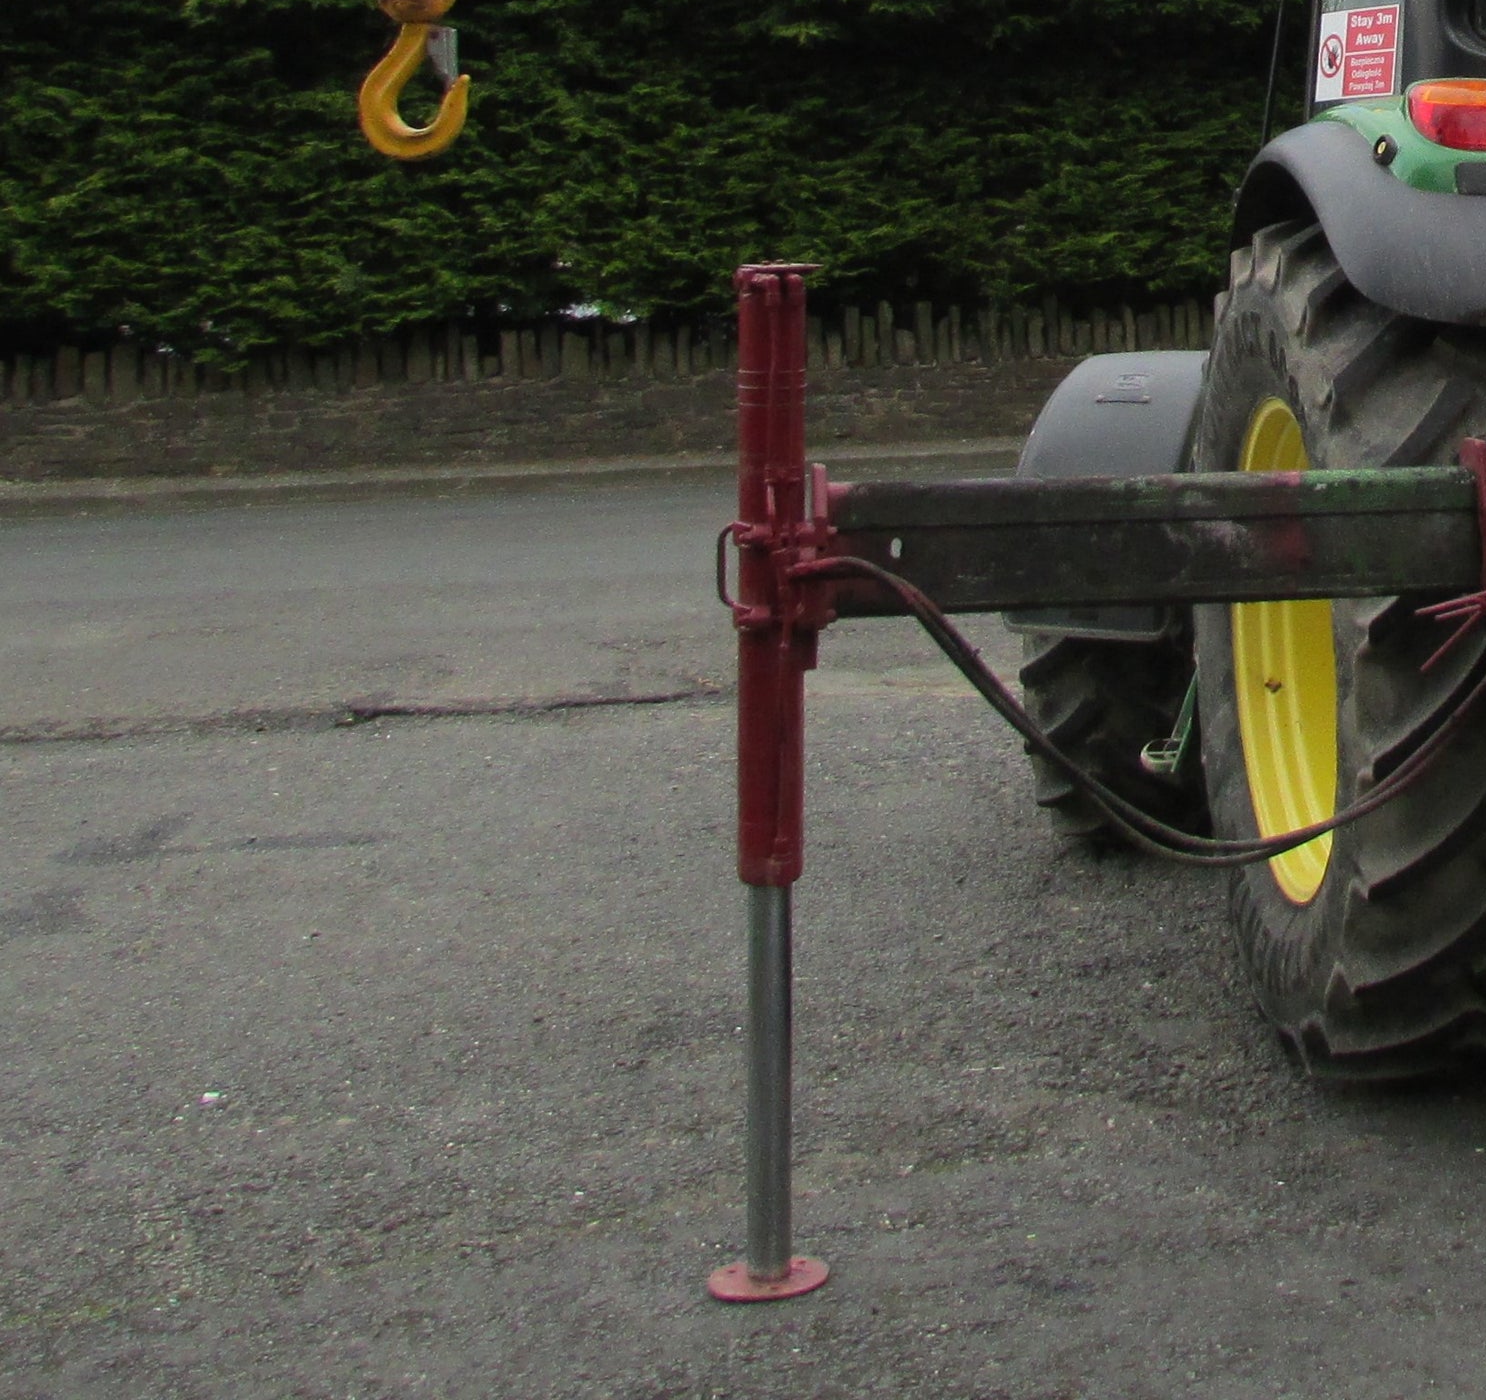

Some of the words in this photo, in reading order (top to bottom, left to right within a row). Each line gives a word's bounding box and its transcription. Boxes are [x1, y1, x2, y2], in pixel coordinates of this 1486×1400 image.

[1350, 15, 1374, 29] Stay
[1376, 12, 1393, 25] 3m
[1355, 32, 1384, 46] Away
